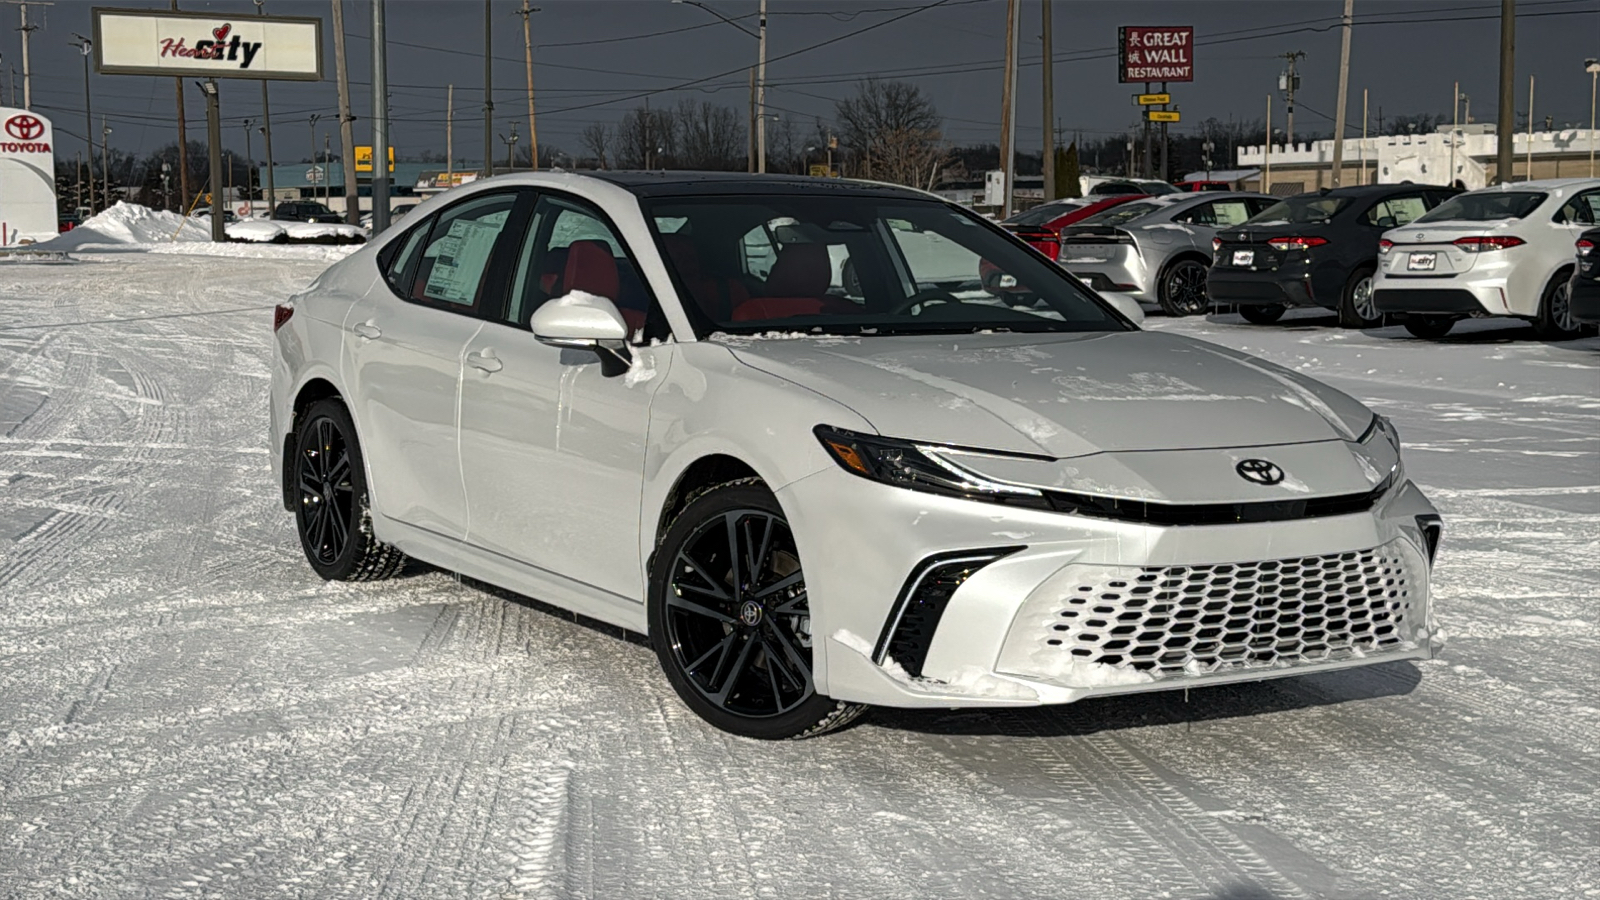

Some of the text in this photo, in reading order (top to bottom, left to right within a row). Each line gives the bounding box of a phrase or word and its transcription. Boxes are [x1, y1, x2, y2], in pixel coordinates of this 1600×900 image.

[1143, 32, 1190, 47] GREAT
[160, 37, 230, 58] Heart
[1144, 49, 1188, 64] WALL
[1127, 66, 1191, 78] RESTAURANT
[1, 142, 52, 153] TOYOTA
